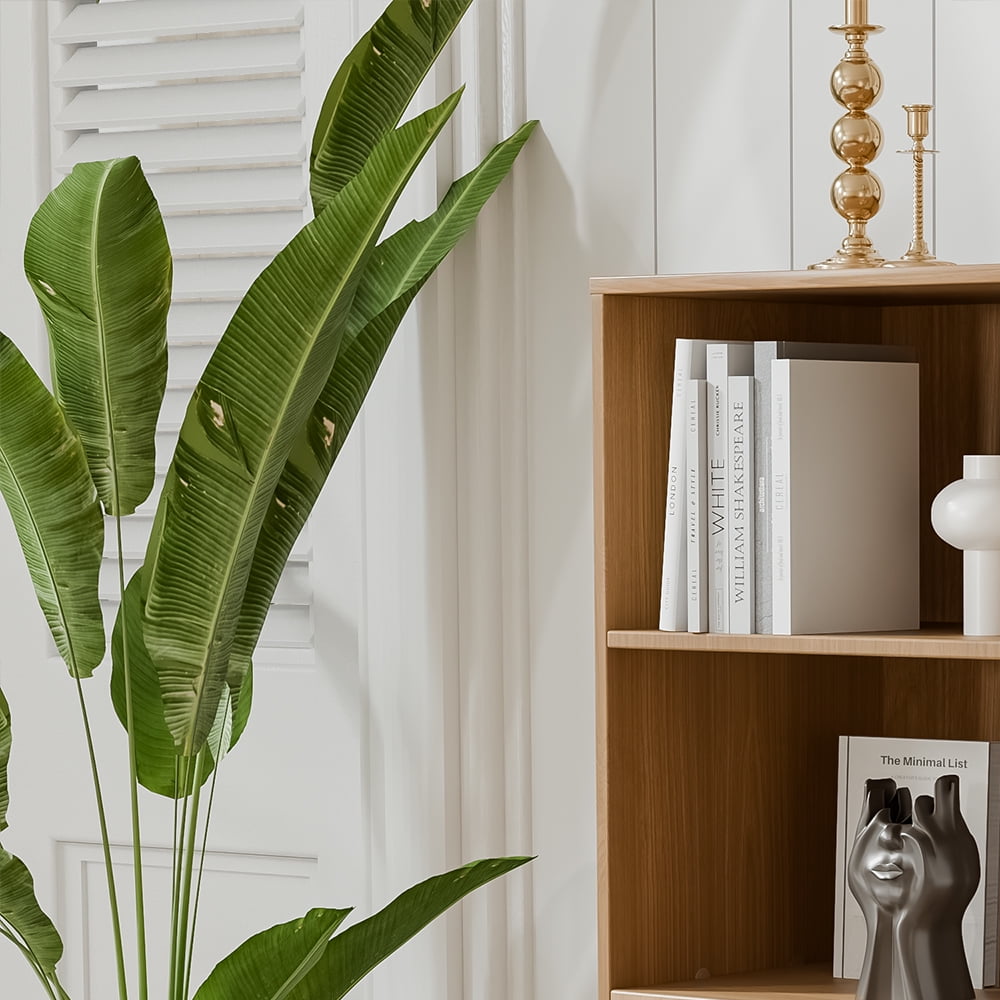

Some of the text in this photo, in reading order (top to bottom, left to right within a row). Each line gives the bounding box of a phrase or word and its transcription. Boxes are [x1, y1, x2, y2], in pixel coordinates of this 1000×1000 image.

[668, 466, 678, 516] LONDON
[711, 458, 725, 536] WHITE
[733, 400, 745, 604] WILLIAM SHAKESPEARE
[880, 755, 968, 769] The Minimal List
